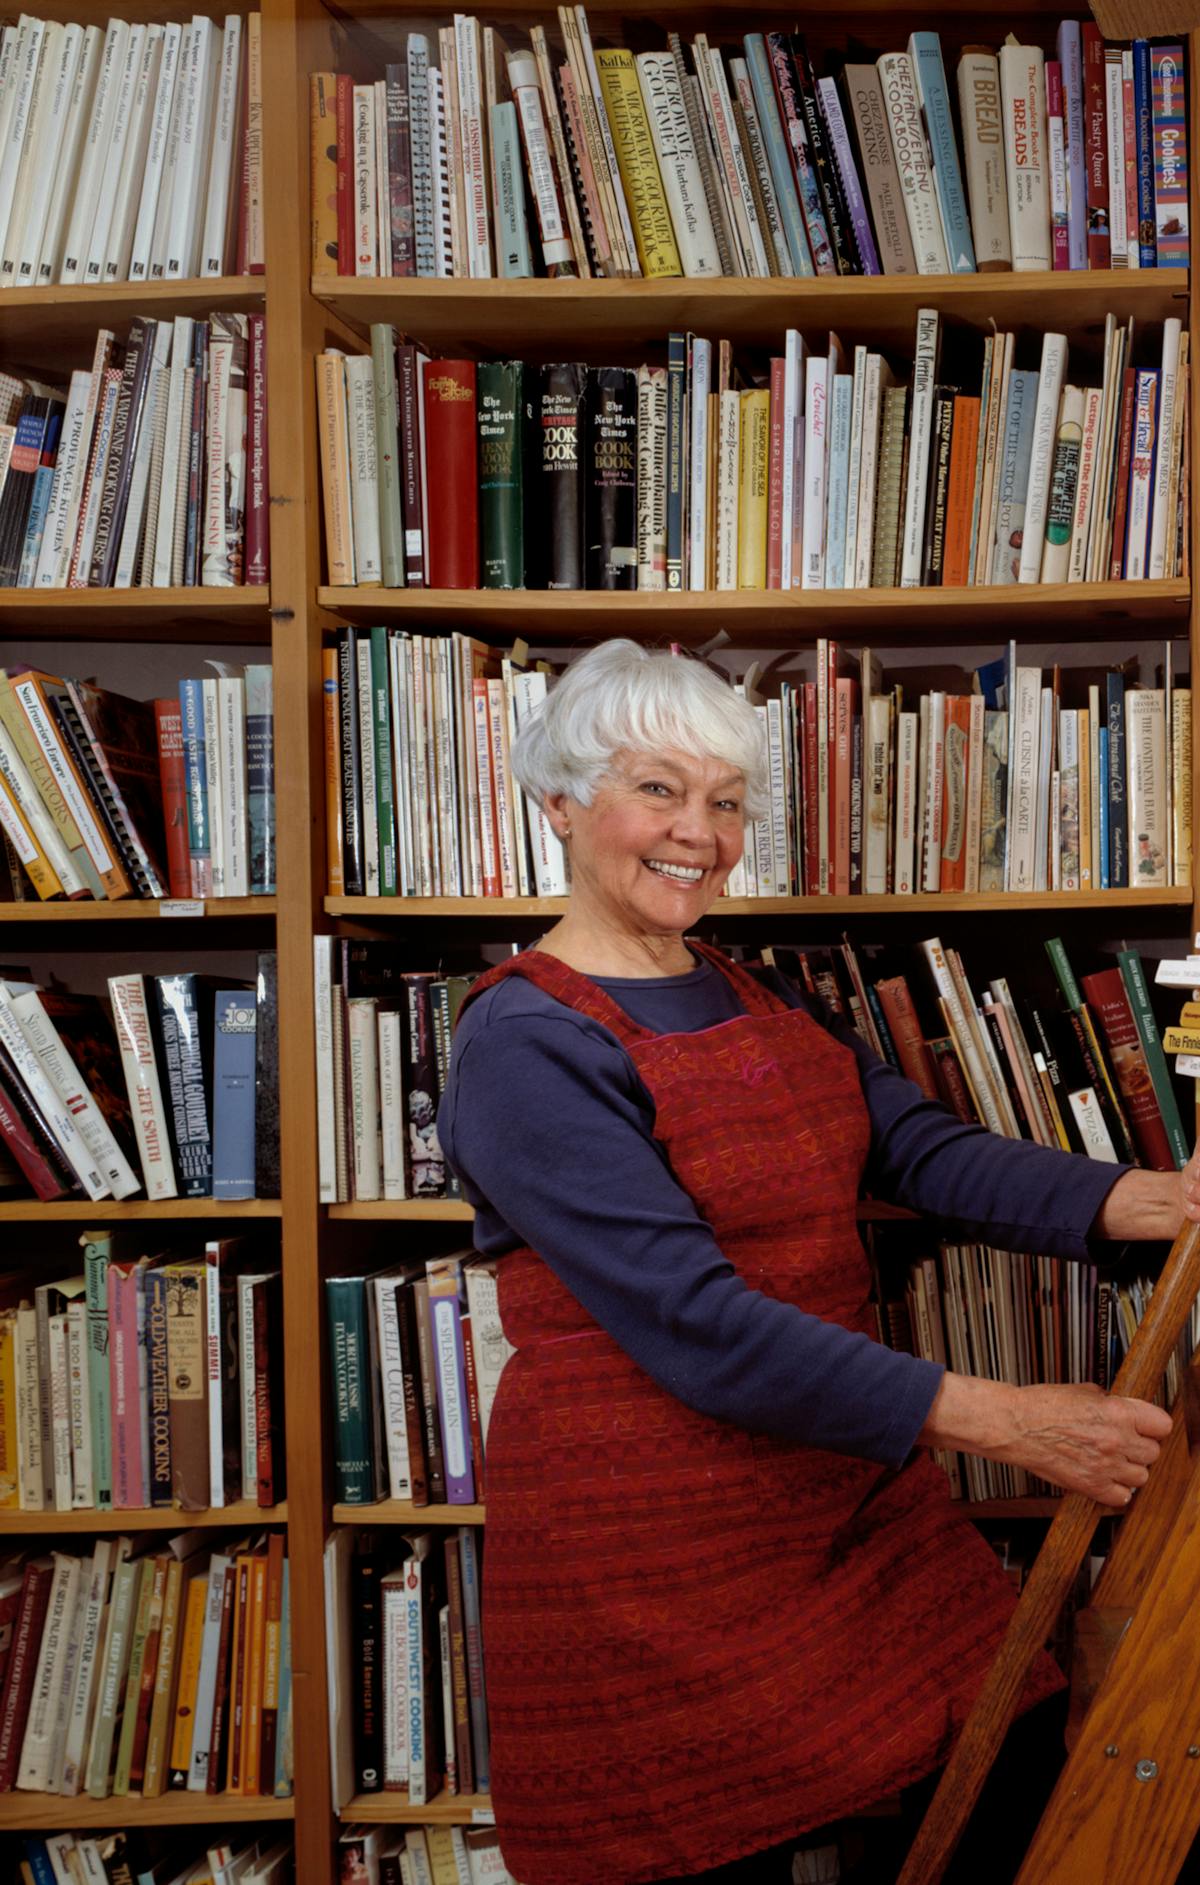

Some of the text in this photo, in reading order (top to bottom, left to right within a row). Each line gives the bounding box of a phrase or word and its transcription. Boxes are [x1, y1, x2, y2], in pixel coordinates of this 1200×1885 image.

[597, 56, 633, 69] Kafka
[643, 59, 696, 234] GOURMET Barbara Kafka
[660, 59, 693, 161] MICROWAVE
[803, 96, 823, 147] America
[868, 90, 891, 166] CHEZ PANISSE
[974, 80, 1000, 143] BREAD
[1013, 99, 1027, 165] BREADS
[1027, 64, 1040, 167] The Complete Book of
[1089, 112, 1104, 148] Pastry
[1161, 62, 1181, 189] Good Housekeeping Cookies!
[606, 73, 657, 256] HEALTHSTYLE COOKBOOK
[624, 89, 672, 247] MICROWAVE GOURMET
[856, 91, 904, 257] COOKING PAUL BERTOLLI
[1093, 152, 1105, 187] Queen
[594, 414, 636, 426] New York
[606, 401, 623, 411] The
[1138, 376, 1154, 408] Soup
[93, 351, 138, 565] THE LA VARENNE COOKING COURSE
[594, 441, 634, 455] COOK
[595, 456, 634, 470] BOOK
[601, 427, 627, 437] Times
[652, 383, 667, 536] Julie Dannenbaum's
[1000, 379, 1025, 529] OUT OF THE STOCKPOT
[1136, 421, 1150, 453] Bread
[637, 381, 653, 565] Creative Cooking School
[1049, 446, 1068, 521] BOOK OF MEAT
[1060, 448, 1079, 522] THE COMPLETE
[1142, 716, 1154, 831] THE CONTINENTAL FLAVOR
[851, 778, 861, 853] COOKING FOR TWO
[126, 981, 153, 1065] THE FRUGAL
[1141, 1013, 1157, 1043] Italian
[1169, 1034, 1182, 1049] The
[162, 1014, 185, 1144] COOKS THREE ANCIENT CUISINES
[183, 1039, 204, 1083] FRUGAL
[353, 1039, 364, 1140] ITALIAN COOKBOOK
[136, 1085, 161, 1163] JEFF SMITH
[185, 1084, 209, 1142] GOURMET
[208, 1335, 219, 1381] SUMMER
[335, 1322, 349, 1422] ITALIAN COOKING
[346, 1332, 358, 1411] MORE CLASSIC
[153, 1416, 170, 1481] COOKING
[257, 1373, 268, 1462] THANKSGIVING
[407, 1600, 422, 1762] SOUTHWEST COOKING
